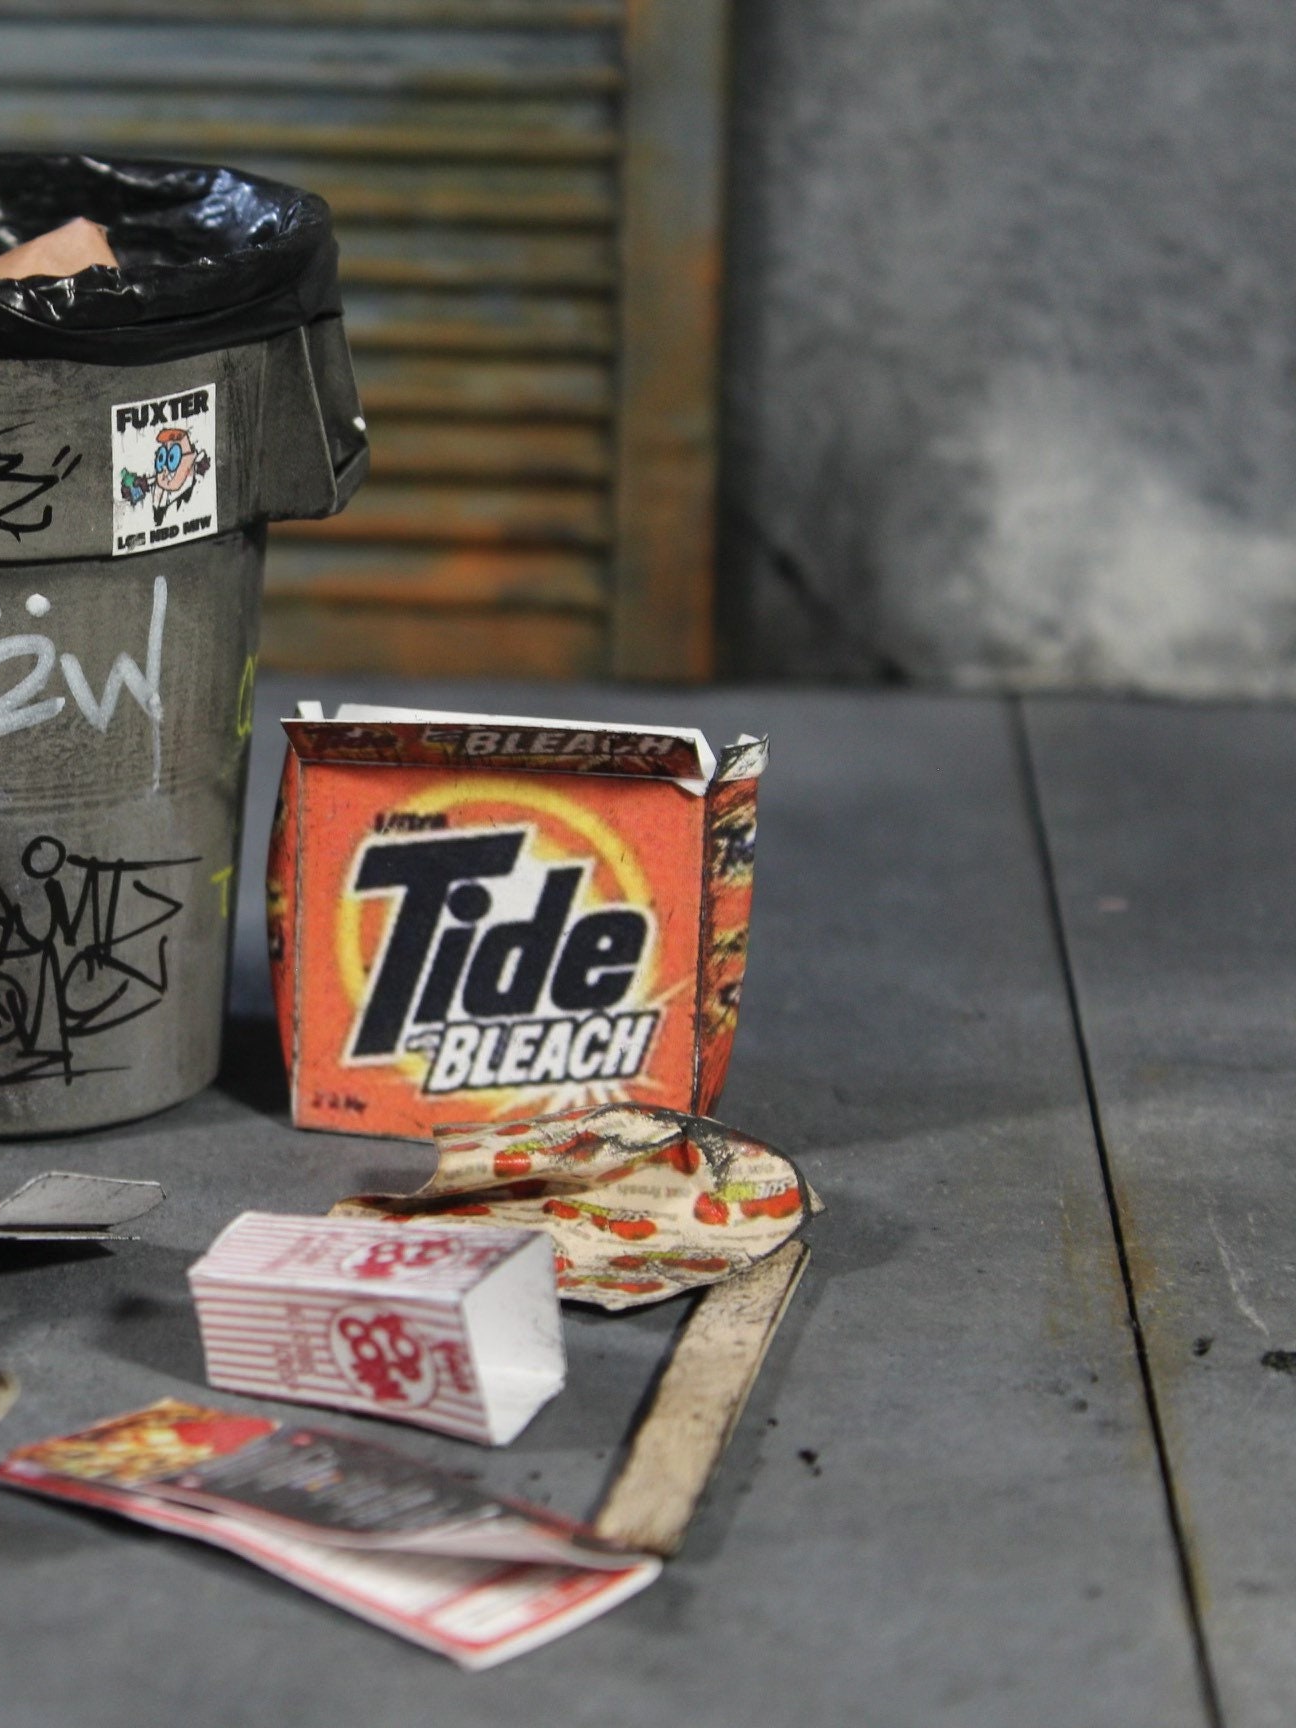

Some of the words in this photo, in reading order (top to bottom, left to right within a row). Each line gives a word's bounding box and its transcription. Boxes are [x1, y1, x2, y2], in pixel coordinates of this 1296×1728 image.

[116, 389, 209, 434] FUXTER
[354, 831, 647, 1058] Tide
[426, 1013, 655, 1093] BLEACH
